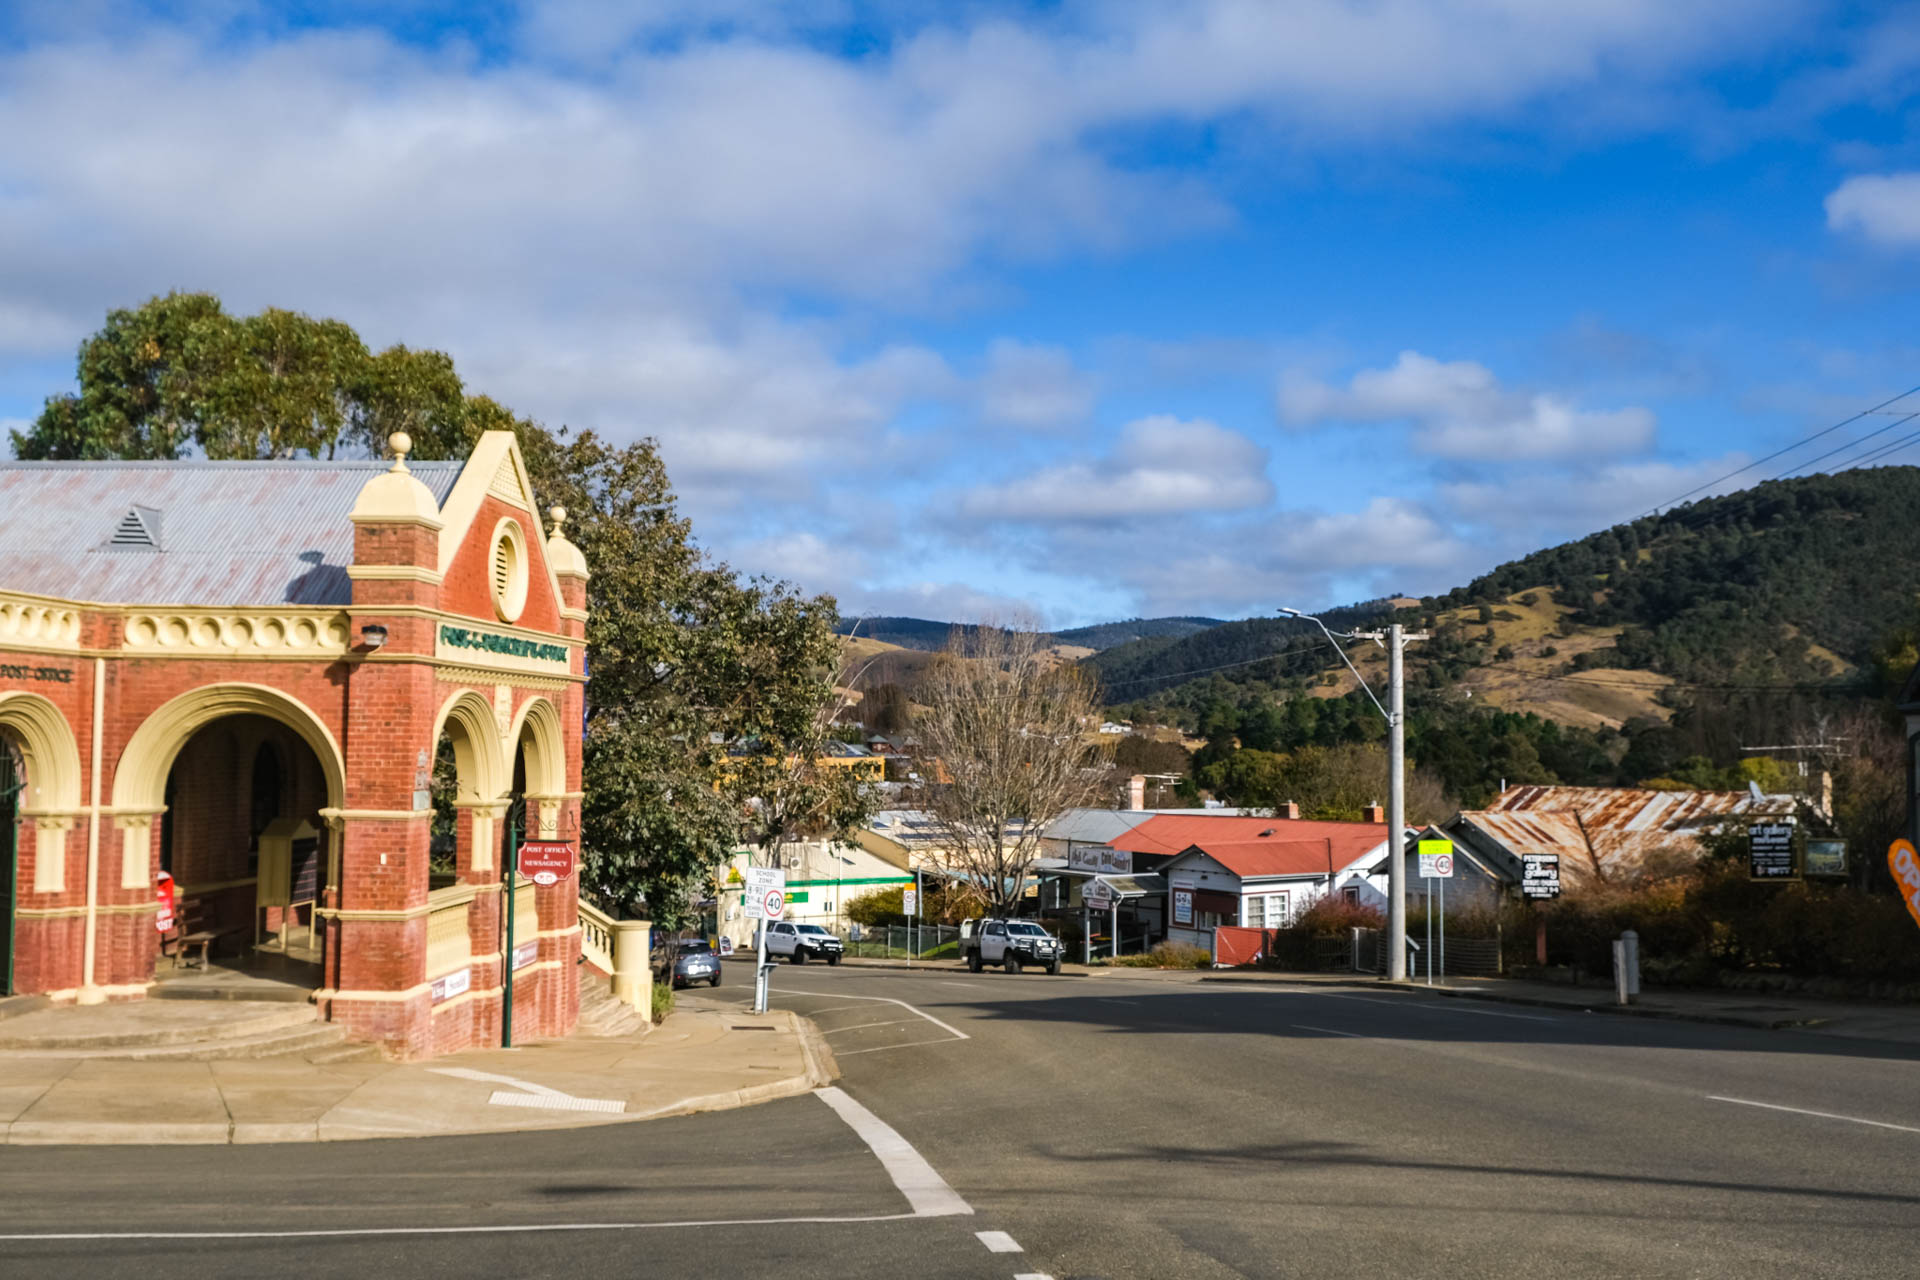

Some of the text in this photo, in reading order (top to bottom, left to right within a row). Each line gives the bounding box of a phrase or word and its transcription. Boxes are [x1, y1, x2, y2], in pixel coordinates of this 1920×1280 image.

[1439, 860, 1450, 869] 40
[756, 870, 777, 878] SCHOOL
[758, 877, 773, 885] ZONE
[767, 897, 781, 910] 40
